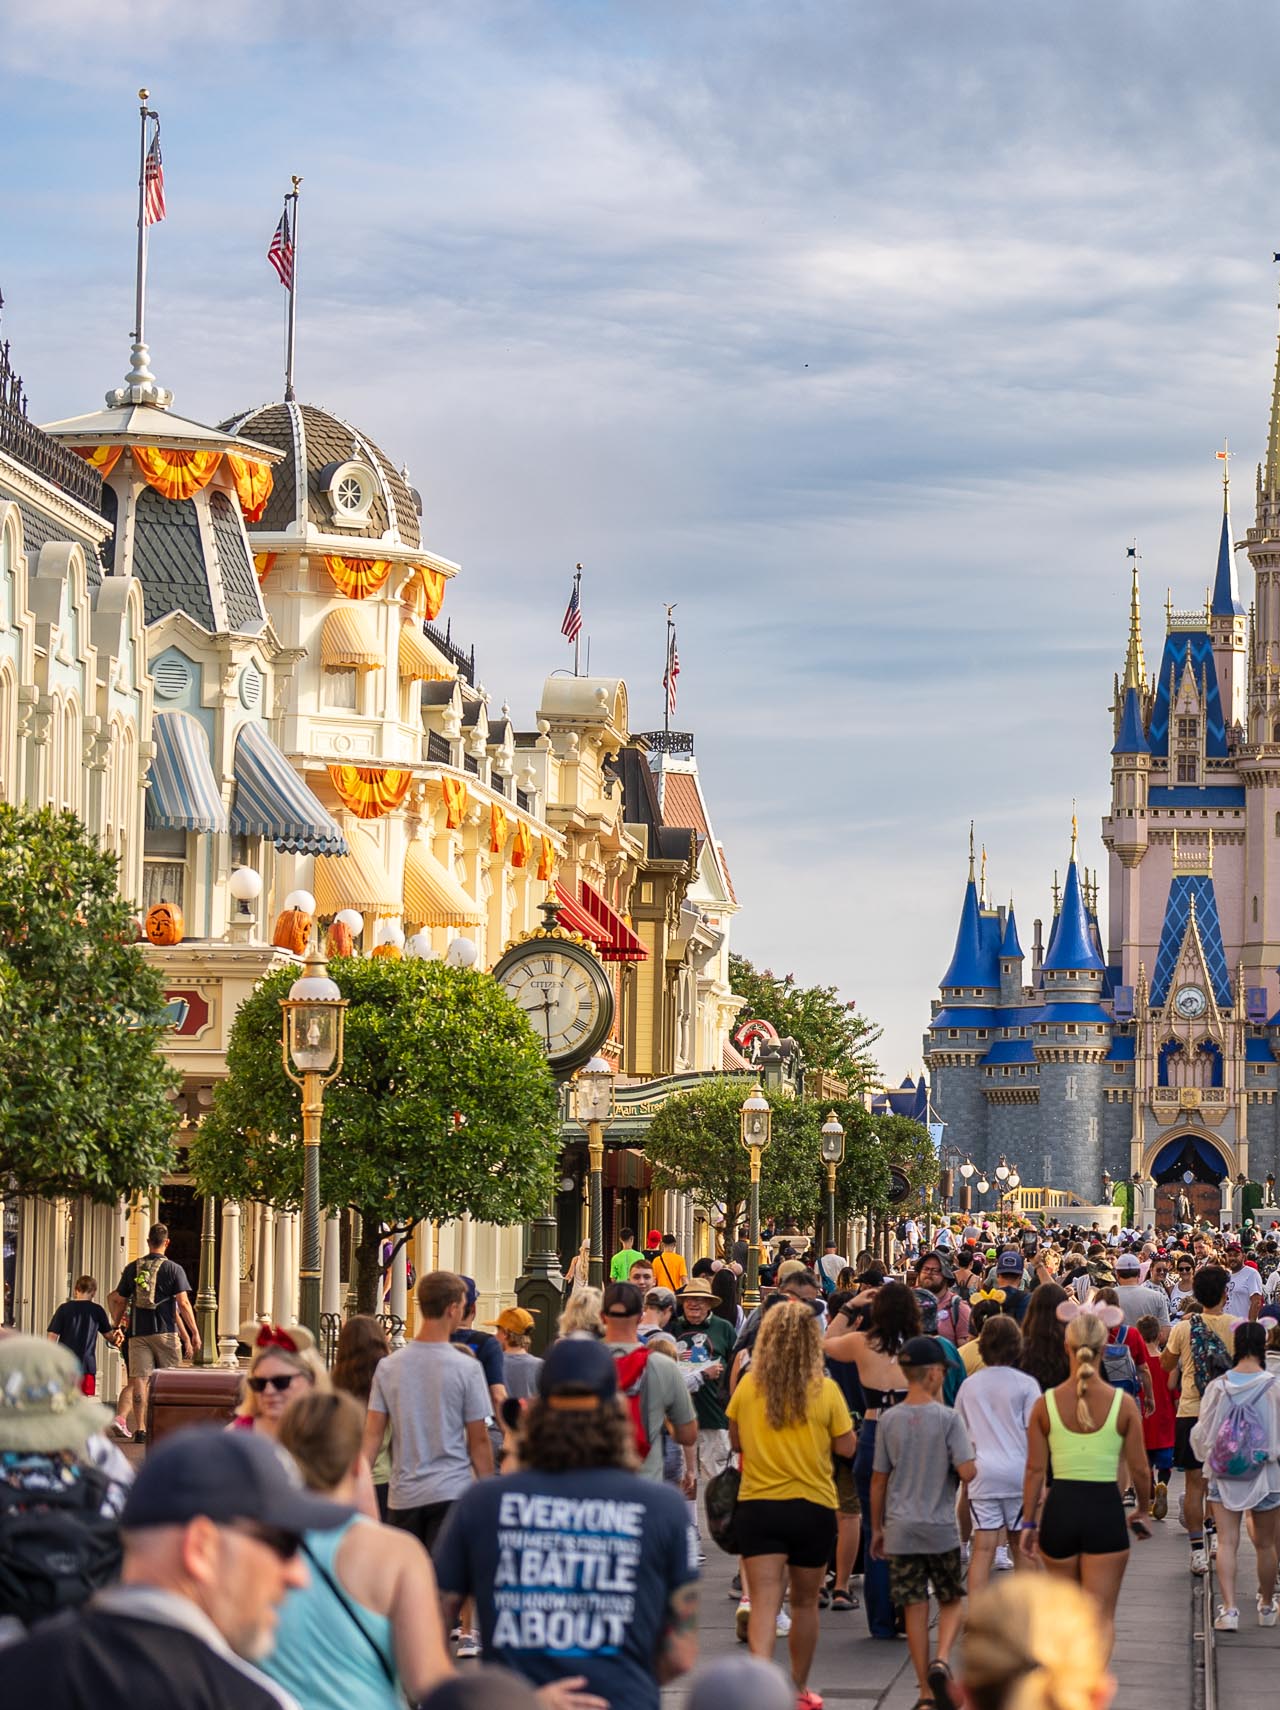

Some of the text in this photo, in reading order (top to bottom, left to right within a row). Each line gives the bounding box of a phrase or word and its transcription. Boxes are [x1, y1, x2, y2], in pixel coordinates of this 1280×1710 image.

[615, 1104, 637, 1118] Main
[500, 1493, 646, 1537] EVERYONE
[494, 1549, 640, 1591] A BATTLE
[492, 1609, 633, 1650] ABOUT
